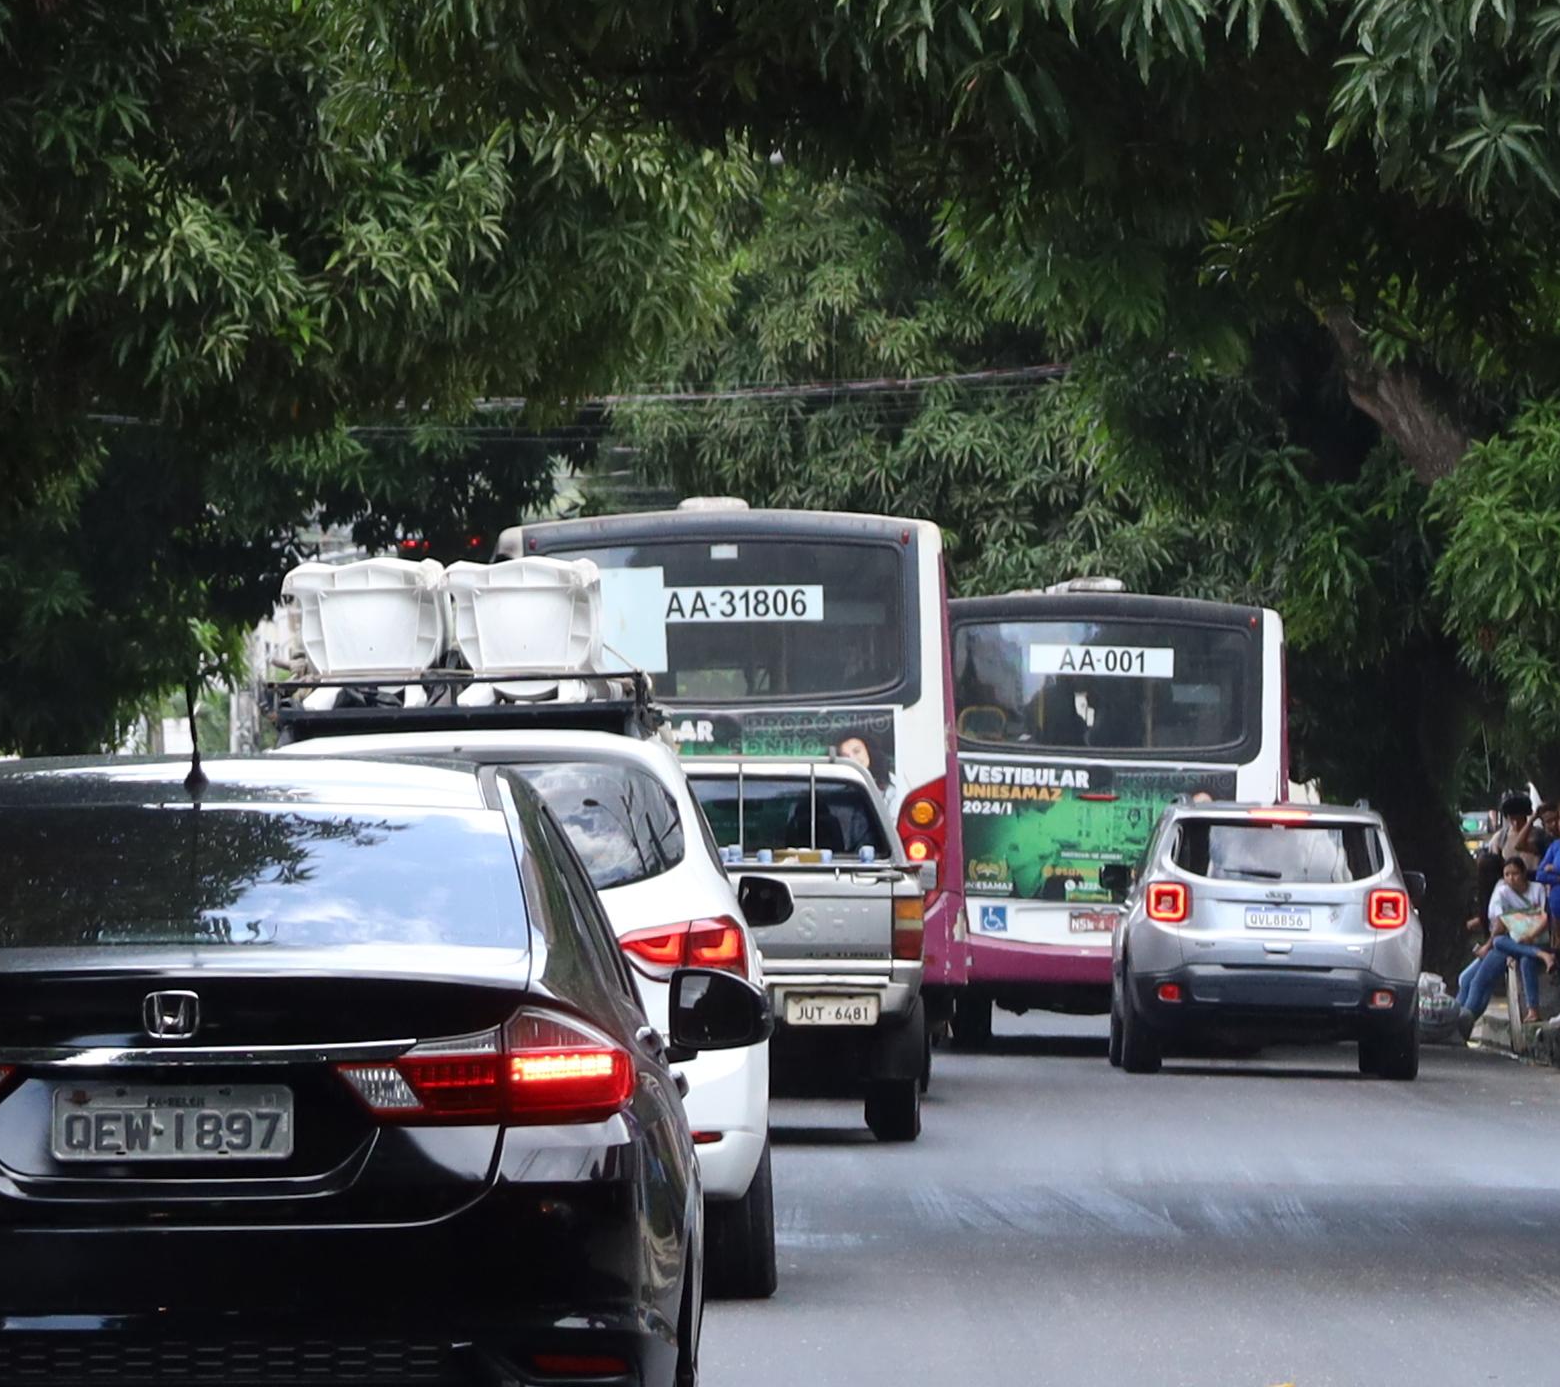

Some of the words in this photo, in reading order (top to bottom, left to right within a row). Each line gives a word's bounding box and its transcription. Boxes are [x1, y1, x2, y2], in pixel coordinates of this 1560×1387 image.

[665, 588, 807, 619] AA-31806
[1059, 647, 1145, 674] AA-001
[963, 764, 1090, 789] VESTIBULAR
[962, 783, 1063, 801] UNIESAMAZ
[962, 800, 1013, 815] 2024/1
